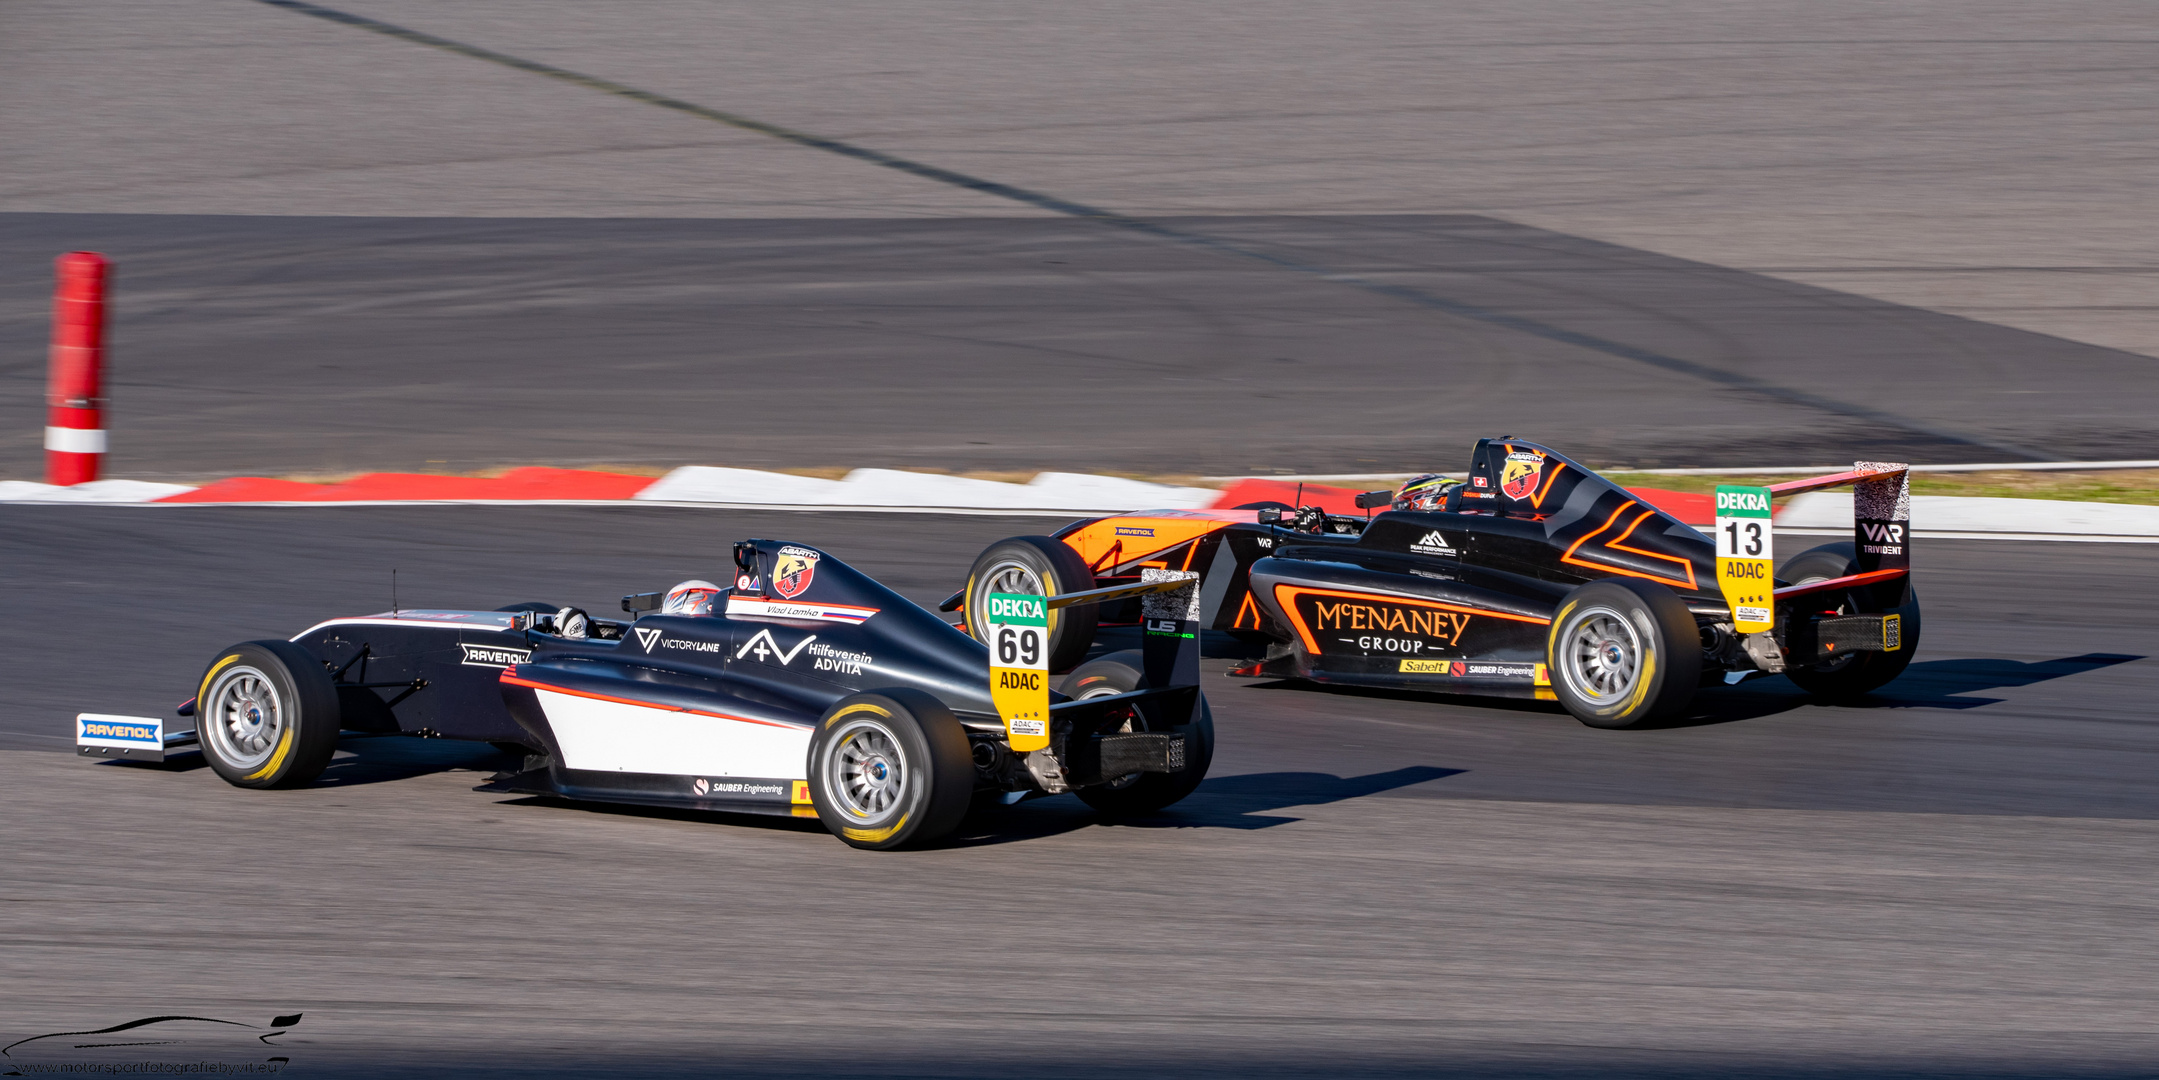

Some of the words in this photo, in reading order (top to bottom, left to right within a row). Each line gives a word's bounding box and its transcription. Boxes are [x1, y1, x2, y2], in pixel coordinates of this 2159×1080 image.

[1510, 452, 1542, 462] ABARTH
[1717, 491, 1768, 511] DEKRA
[1118, 528, 1152, 536] RAVENOL
[1725, 521, 1762, 556] 13
[1862, 523, 1903, 543] VAR
[1257, 537, 1272, 548] VAR
[1863, 545, 1902, 555] TRIVIDENT
[781, 547, 818, 559] ABARTH
[1726, 562, 1764, 579] ADAC
[767, 605, 786, 614] Vlad
[991, 597, 1045, 618] DEKRA
[1147, 620, 1176, 632] US
[1147, 631, 1195, 639] RACING
[661, 638, 720, 653] VICTORYLANE
[998, 628, 1040, 665] 69
[1358, 636, 1423, 653] GROUP
[469, 649, 526, 664] RAVENOL
[808, 643, 872, 664] Hilfeverein
[814, 657, 862, 676] ADVITA
[1405, 660, 1444, 672] Sabelt
[1469, 665, 1497, 674] SAUBER
[1498, 665, 1534, 678] Engineering
[1000, 671, 1040, 690] ADAC
[86, 723, 154, 739] RAVENOL
[1013, 720, 1032, 728] ADAC
[713, 782, 743, 793] SAUBER
[743, 783, 783, 796] Engineering
